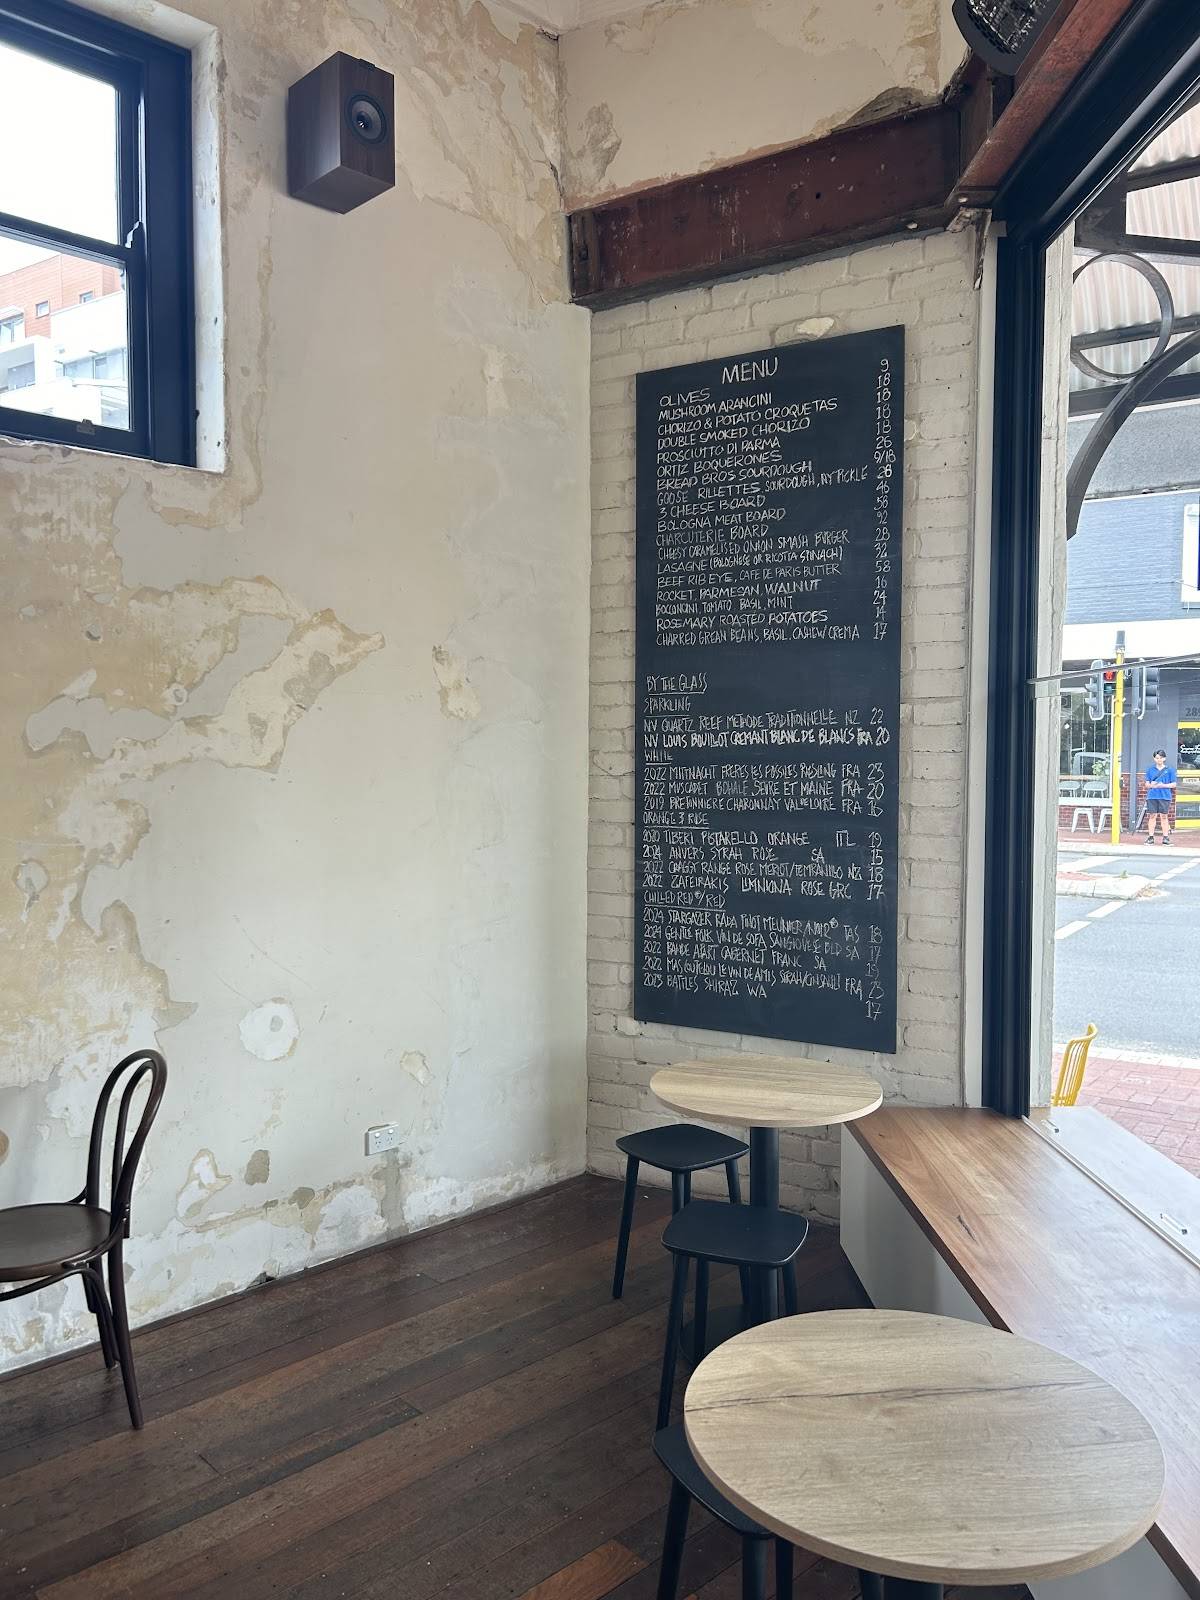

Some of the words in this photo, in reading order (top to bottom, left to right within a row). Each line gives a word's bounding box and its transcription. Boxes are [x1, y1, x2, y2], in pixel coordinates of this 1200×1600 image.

[722, 357, 778, 384] MENU
[880, 358, 889, 372] 9
[876, 372, 890, 389] 18
[658, 387, 710, 406] OLIVES
[876, 387, 891, 403] 18
[658, 402, 716, 421] MUSHROOM
[717, 391, 772, 413] ARANCINI
[876, 403, 891, 419] 18
[657, 419, 701, 435] CHORIZO
[703, 417, 712, 429] &
[714, 410, 761, 427] POTATO
[763, 397, 837, 419] CROQUETAS
[656, 432, 696, 450] DOUBLE
[699, 427, 748, 443] SMOKED
[751, 416, 810, 436] CHORIZO
[876, 419, 891, 435] 18
[656, 444, 724, 464] PROSCIUTTO
[726, 442, 738, 454] DI
[740, 436, 781, 452] PARMA
[875, 435, 892, 449] 26
[656, 463, 688, 477] ORTIZ
[693, 449, 782, 473] BOQUERONES
[873, 449, 896, 463] 9/18
[656, 475, 698, 490] BREAD
[701, 470, 736, 485] BROS
[739, 460, 812, 480] SOURDOUGH
[876, 480, 889, 494] 46
[656, 490, 688, 506] GOOSE
[658, 507, 667, 520] 3
[669, 500, 716, 518] CHEESE
[719, 494, 766, 510] BOARD
[873, 494, 888, 510] 58
[656, 515, 711, 532] BOLOGNA
[714, 512, 743, 526] MEAT
[746, 507, 786, 522] BOARD
[876, 509, 888, 524] 92
[655, 528, 725, 546] CHARCUTERIE
[730, 522, 769, 540] BOARD
[777, 533, 808, 550] SMASH
[875, 526, 890, 541] 28
[873, 542, 887, 558] 32
[656, 560, 707, 575] LASAGNE
[873, 559, 890, 573] 58
[656, 574, 686, 589] BEEF
[687, 572, 706, 585] RIB
[739, 568, 760, 580] CAFE
[762, 568, 773, 579] DE
[774, 565, 800, 578] PARIS
[802, 562, 842, 577] BUTTER
[875, 574, 888, 589] 16
[764, 578, 821, 595] WALNUT
[767, 594, 793, 609] MINT
[872, 589, 887, 605] 24
[655, 614, 716, 632] ROSEMARY
[719, 612, 765, 627] ROASTED
[768, 609, 829, 625] POTATOES
[875, 605, 887, 620] 14
[656, 630, 697, 646] CHARRED
[828, 624, 861, 640] CREMA
[873, 621, 888, 640] 17
[646, 674, 659, 691] BY
[660, 675, 675, 690] THE
[678, 671, 707, 692] GLASS
[643, 695, 690, 714] SPARKLING
[698, 714, 723, 730] REEF
[870, 706, 884, 724] 22
[644, 733, 658, 748] NV
[662, 733, 687, 748] LOUIS
[801, 729, 815, 742] DE
[874, 726, 890, 746] 20
[643, 766, 667, 780] 2022
[841, 762, 860, 778] FRA
[643, 780, 666, 796] 2022
[783, 780, 798, 795] ET
[800, 780, 834, 796] MAINE
[866, 782, 884, 800] 20
[766, 830, 810, 846] ORANGE
[811, 846, 825, 864] SA
[869, 848, 884, 865] 15
[800, 880, 825, 896] ROSE
[813, 953, 826, 971] SA
[746, 982, 767, 998] WA
[864, 1000, 881, 1020] 17
